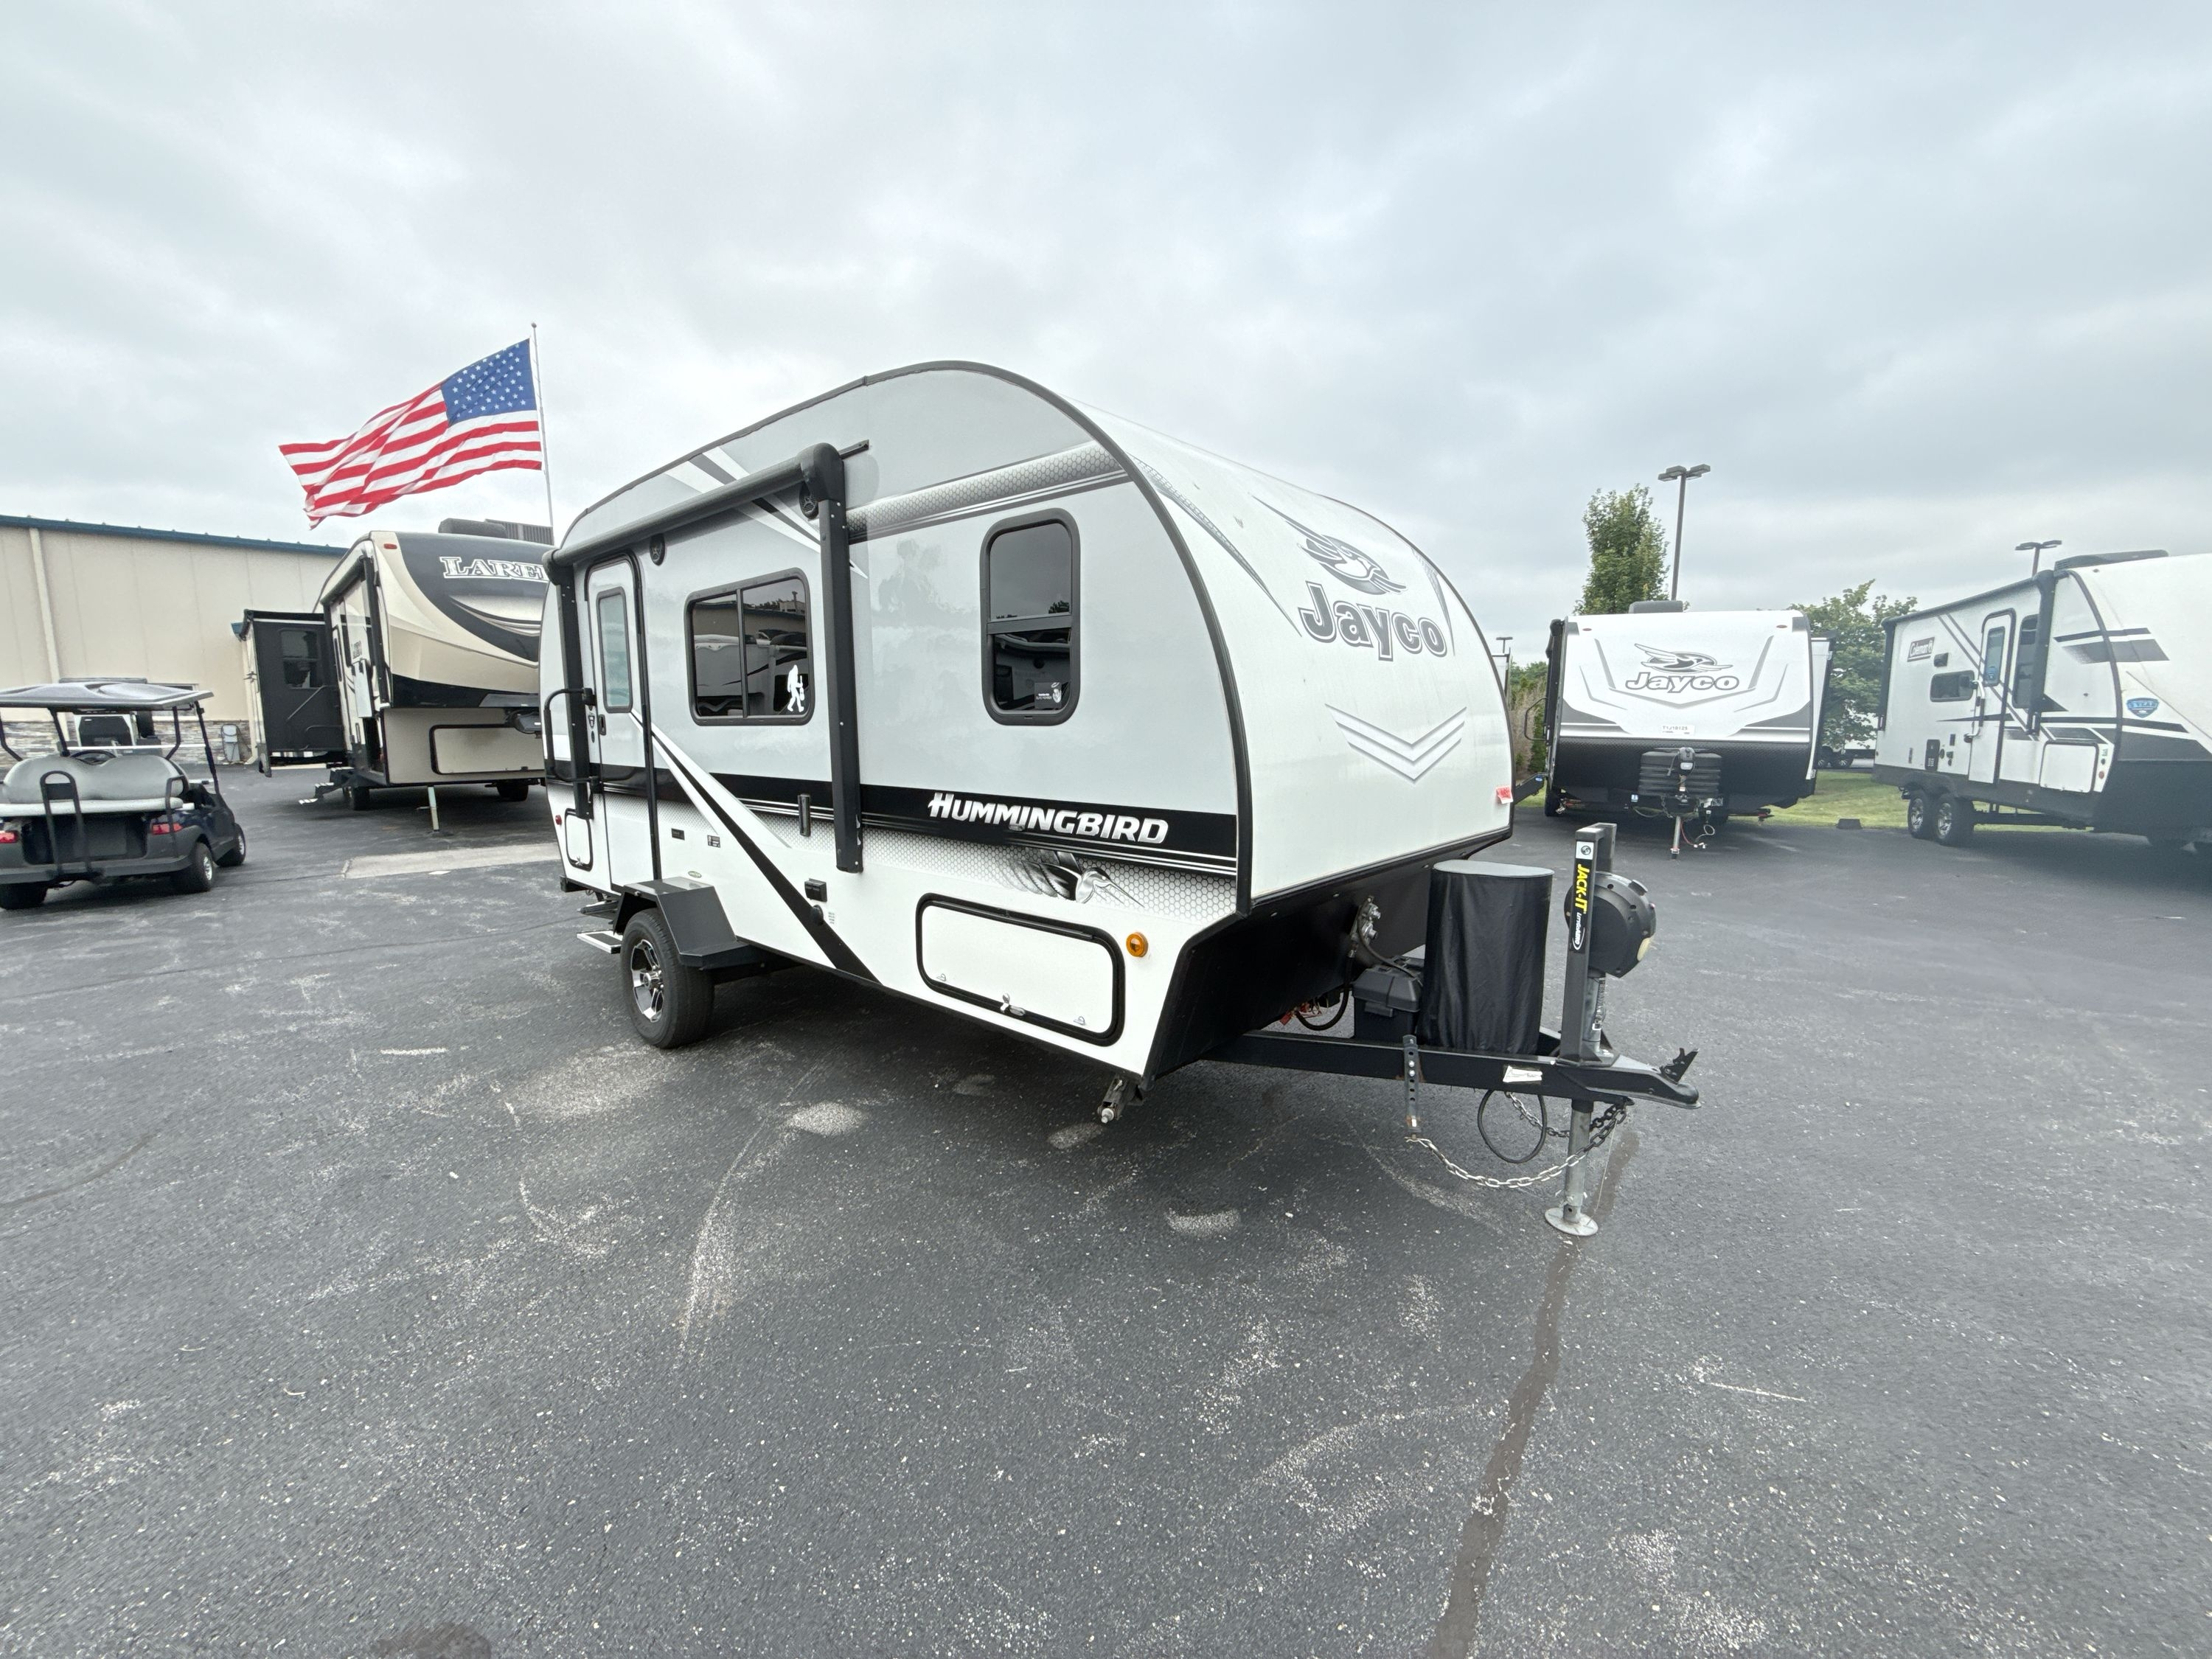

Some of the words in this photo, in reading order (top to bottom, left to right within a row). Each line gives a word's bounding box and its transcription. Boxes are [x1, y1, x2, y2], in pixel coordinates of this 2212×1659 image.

[1298, 580, 1447, 662] Jayco
[1625, 672, 1739, 693] Jayco
[928, 792, 1169, 844] HUMMINGBIRD
[1575, 863, 1590, 912] JACK-IT
